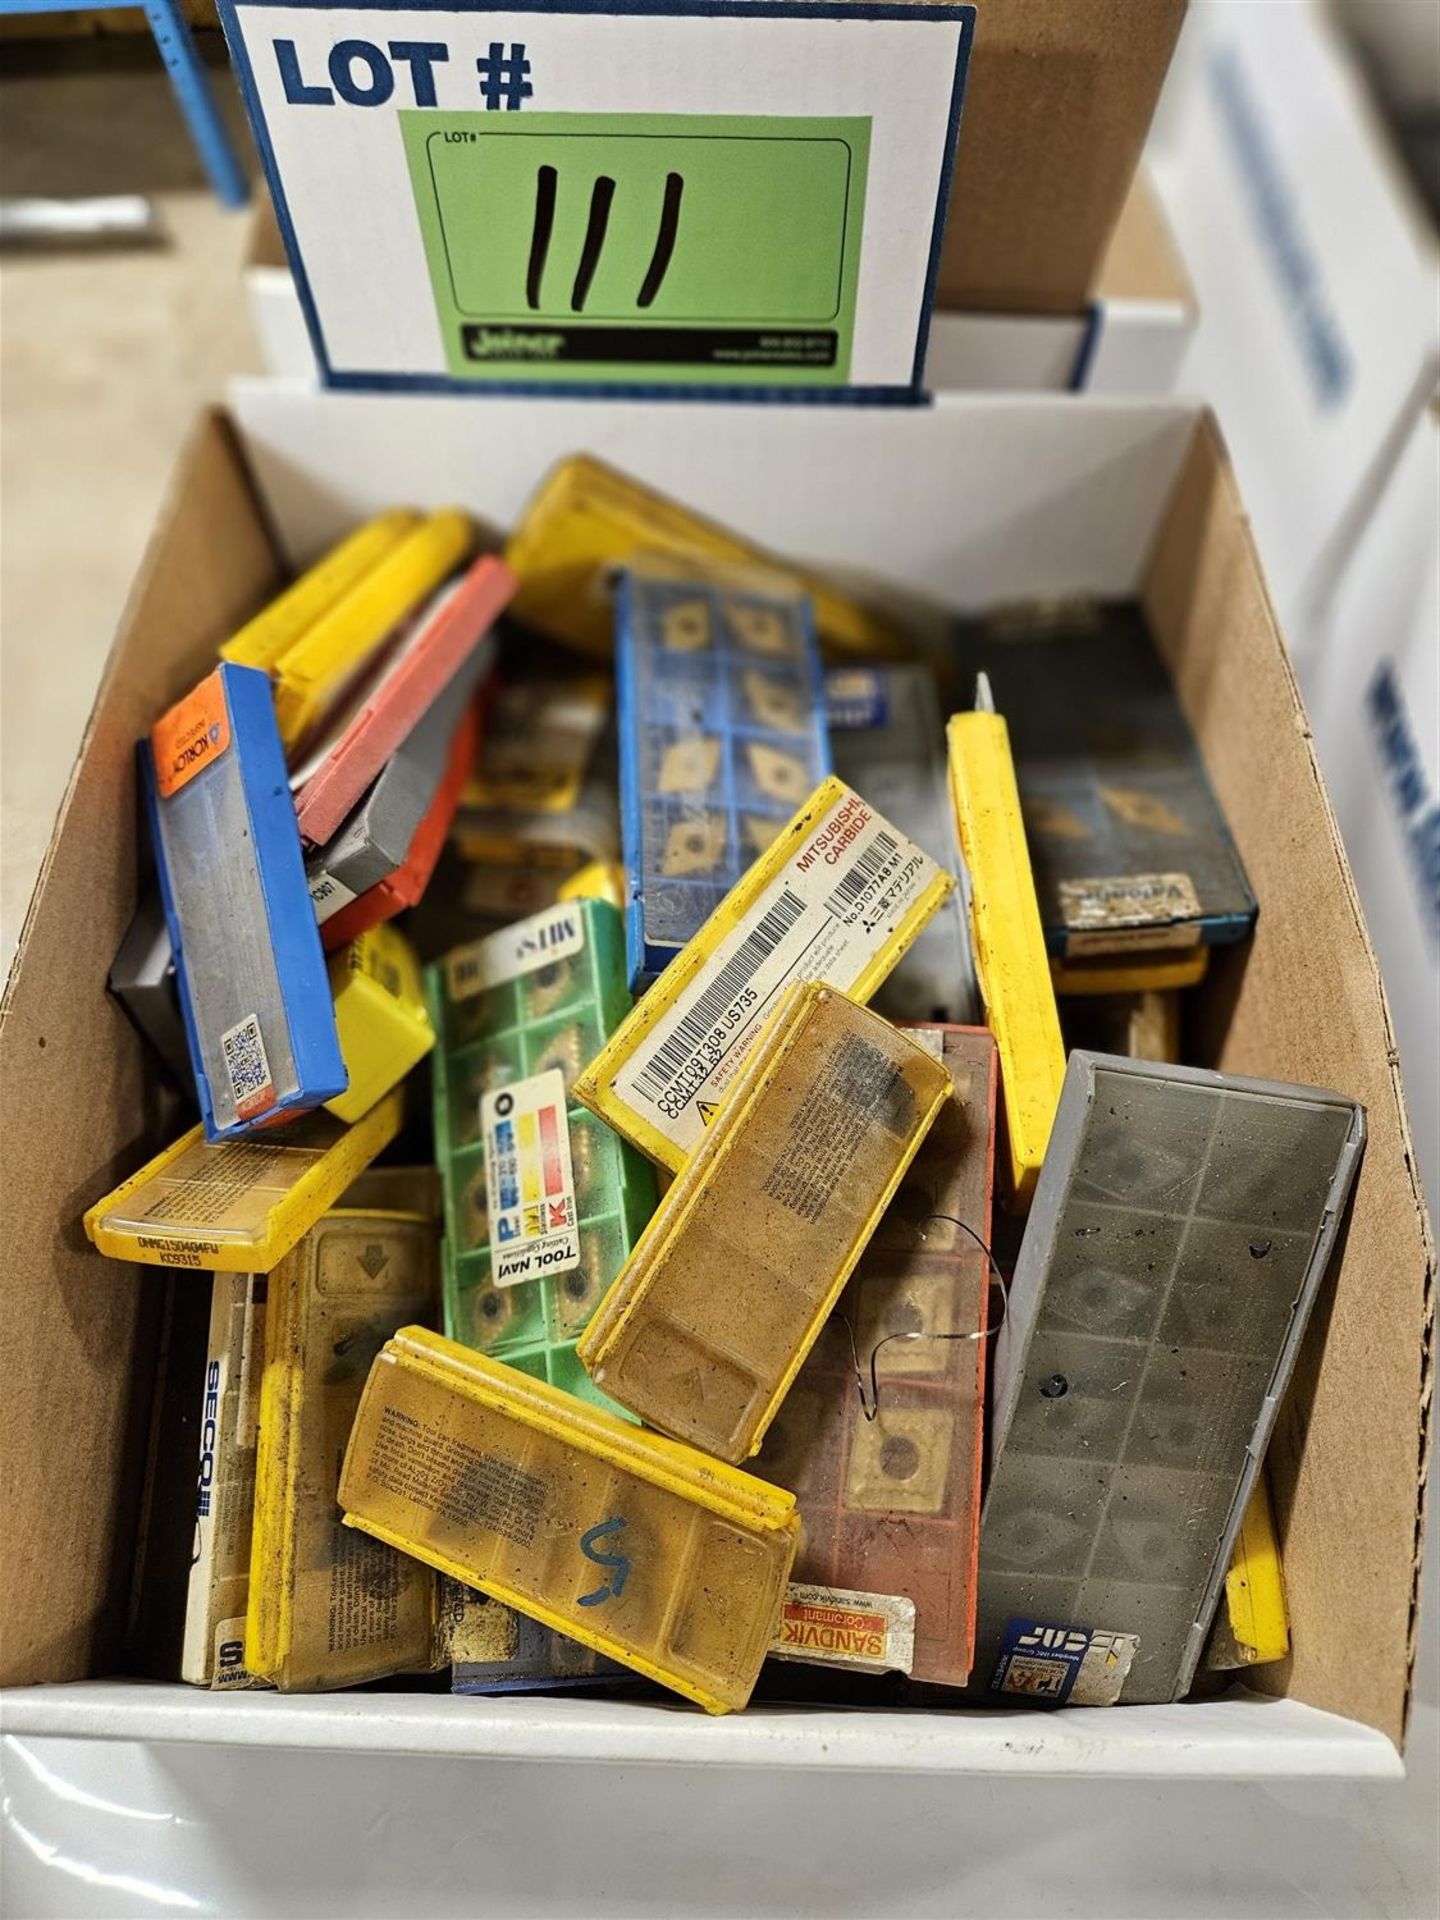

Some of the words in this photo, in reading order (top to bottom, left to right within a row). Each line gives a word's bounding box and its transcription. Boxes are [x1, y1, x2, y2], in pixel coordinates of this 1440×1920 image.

[272, 39, 449, 107] LOT
[476, 42, 534, 111] #
[525, 164, 685, 311] 111
[794, 796, 860, 874] MITSUBISHI
[821, 807, 872, 867] CARBIDE
[654, 1025, 728, 1115] CCMT09T308
[720, 986, 758, 1030] US735
[708, 1055, 737, 1088] SAFETY
[732, 1021, 763, 1058] WARNING
[548, 1198, 567, 1227] K
[494, 1256, 533, 1279] NAVI
[533, 1244, 576, 1268] TOOL
[199, 1361, 220, 1487] SECO
[781, 1620, 883, 1656] SANDVIK
[802, 1607, 865, 1629] Coromant
